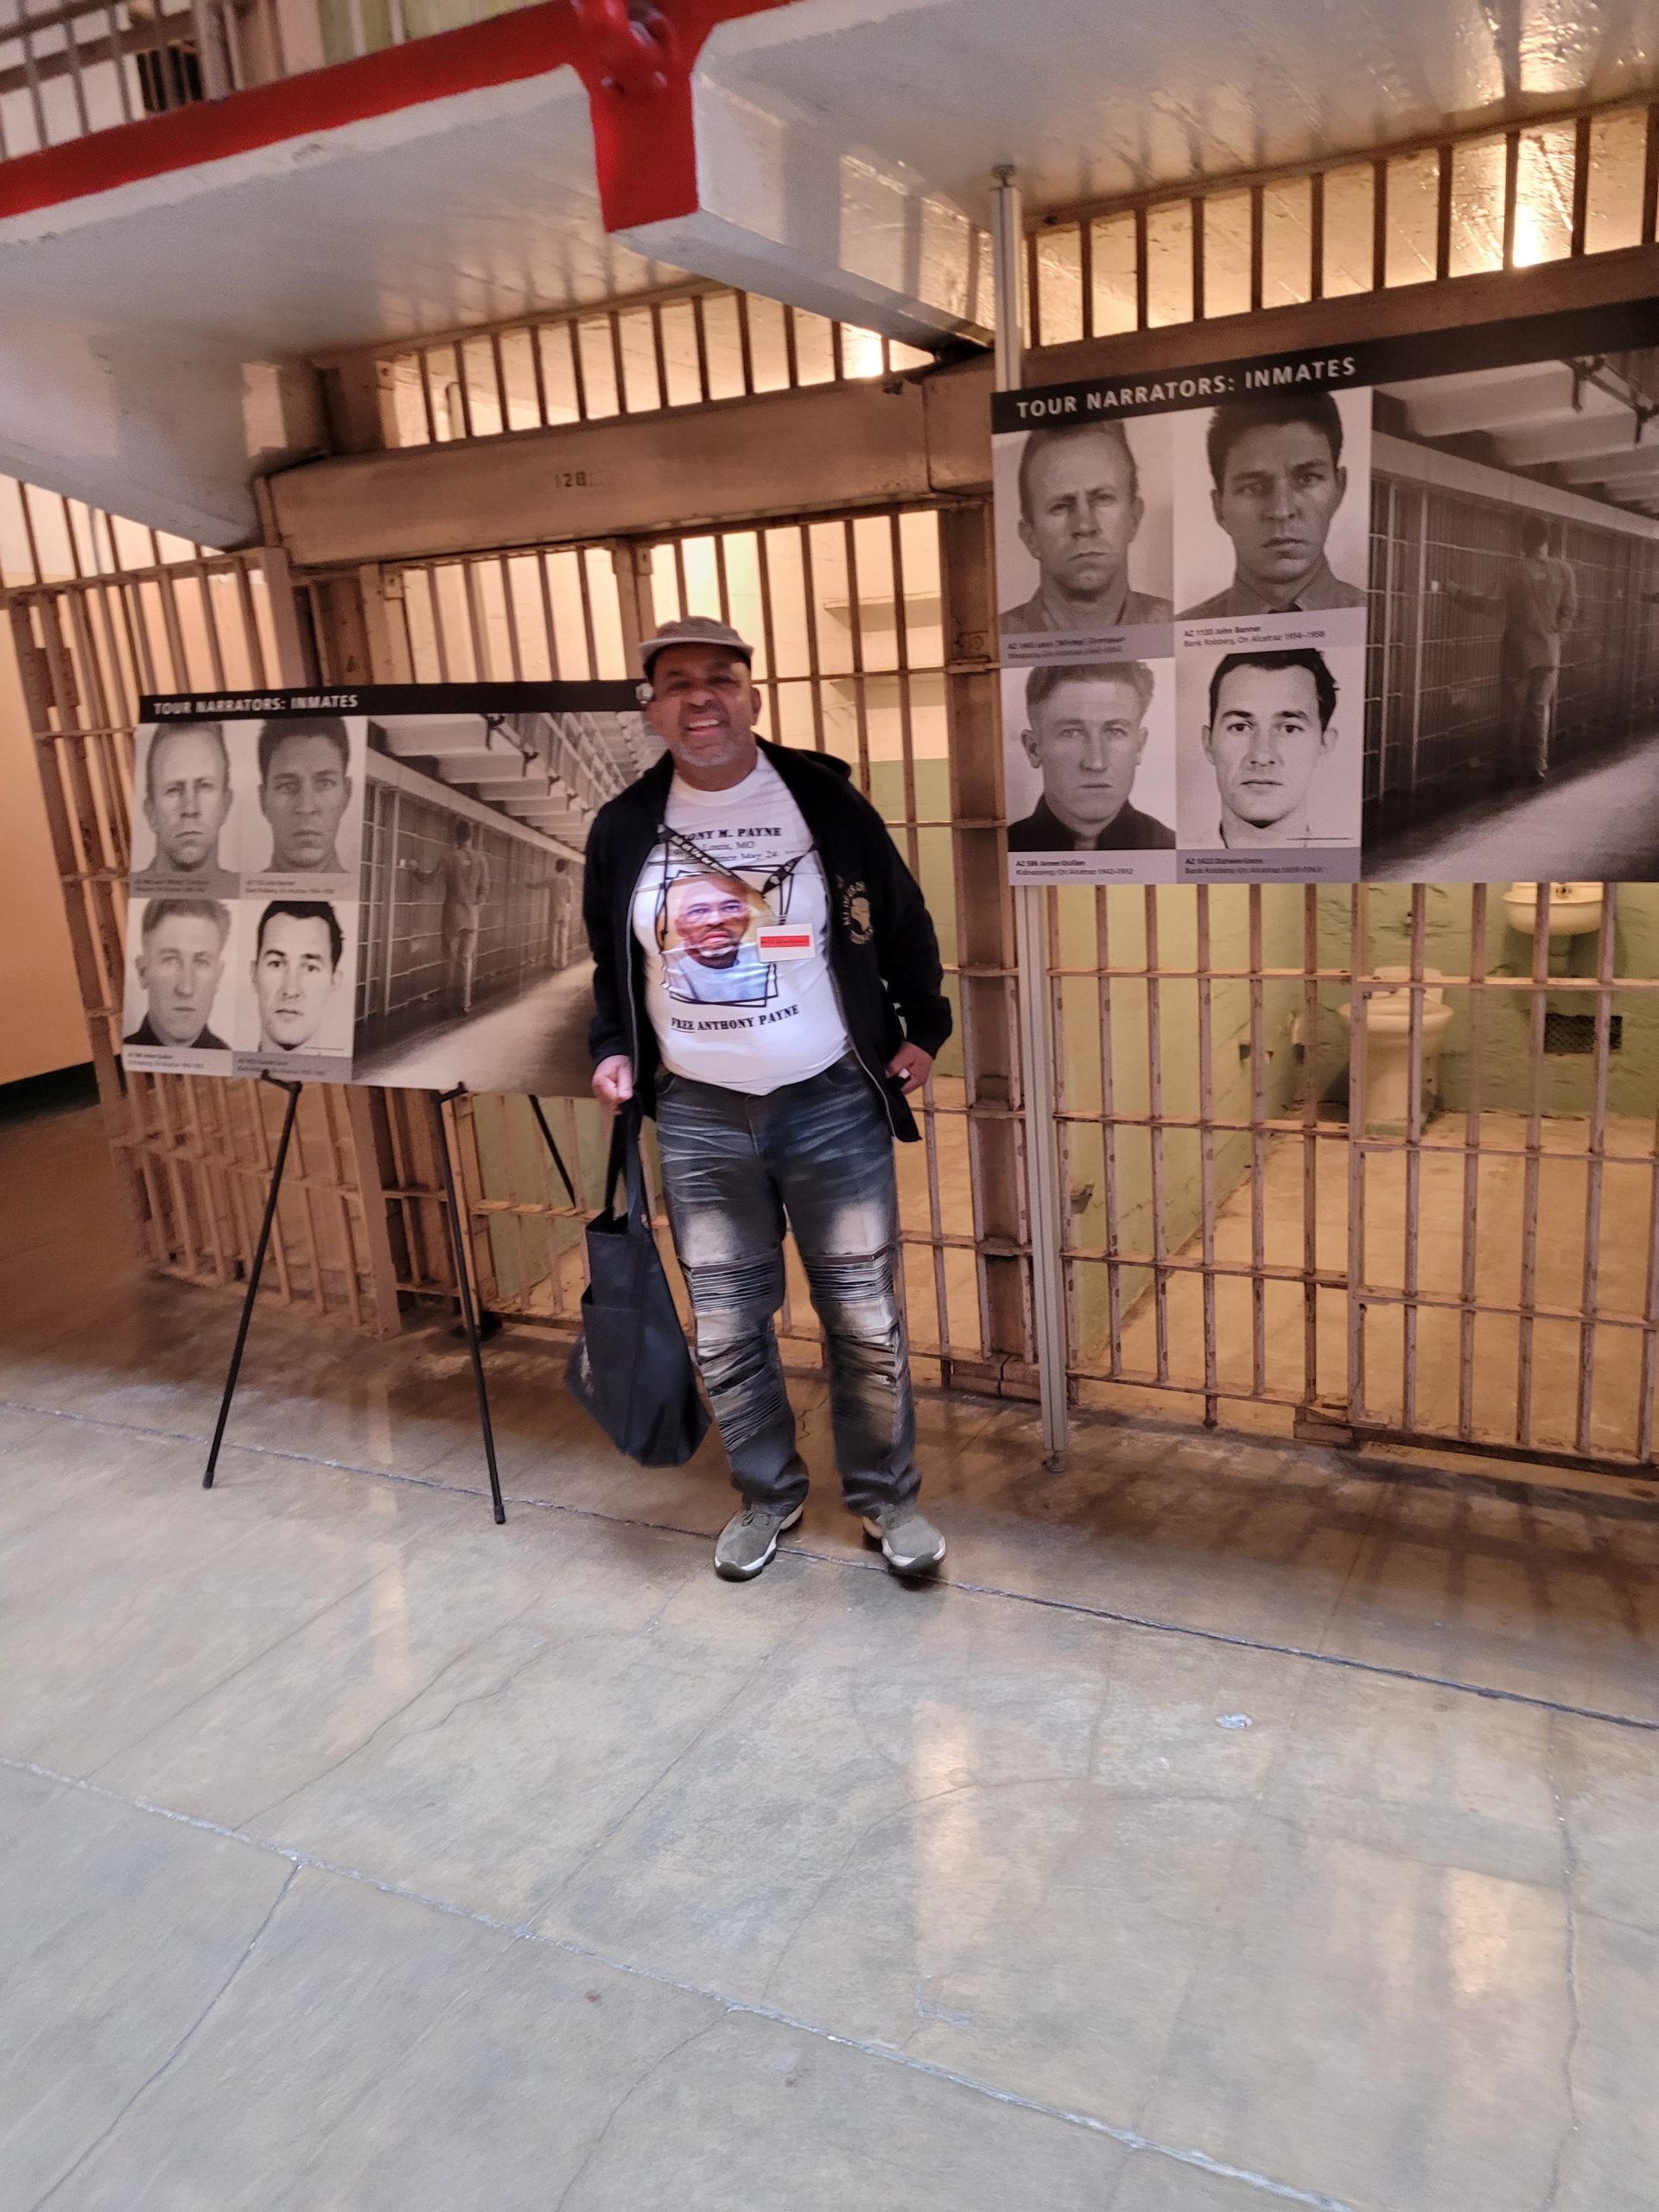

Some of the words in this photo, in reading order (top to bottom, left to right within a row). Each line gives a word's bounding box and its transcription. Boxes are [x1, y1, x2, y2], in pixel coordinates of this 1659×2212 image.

[1017, 396, 1077, 419] TOUR
[1086, 375, 1236, 411] NARRATORS:
[1245, 357, 1357, 389] INMATES
[153, 702, 191, 715] TOUR
[195, 697, 286, 714] NARRATORS:
[290, 695, 358, 709] INMATES
[738, 827, 781, 837] PAYNE
[671, 1017, 694, 1031] FREE
[697, 1017, 754, 1031] ANTHONY
[759, 1004, 799, 1026] PAYNE
